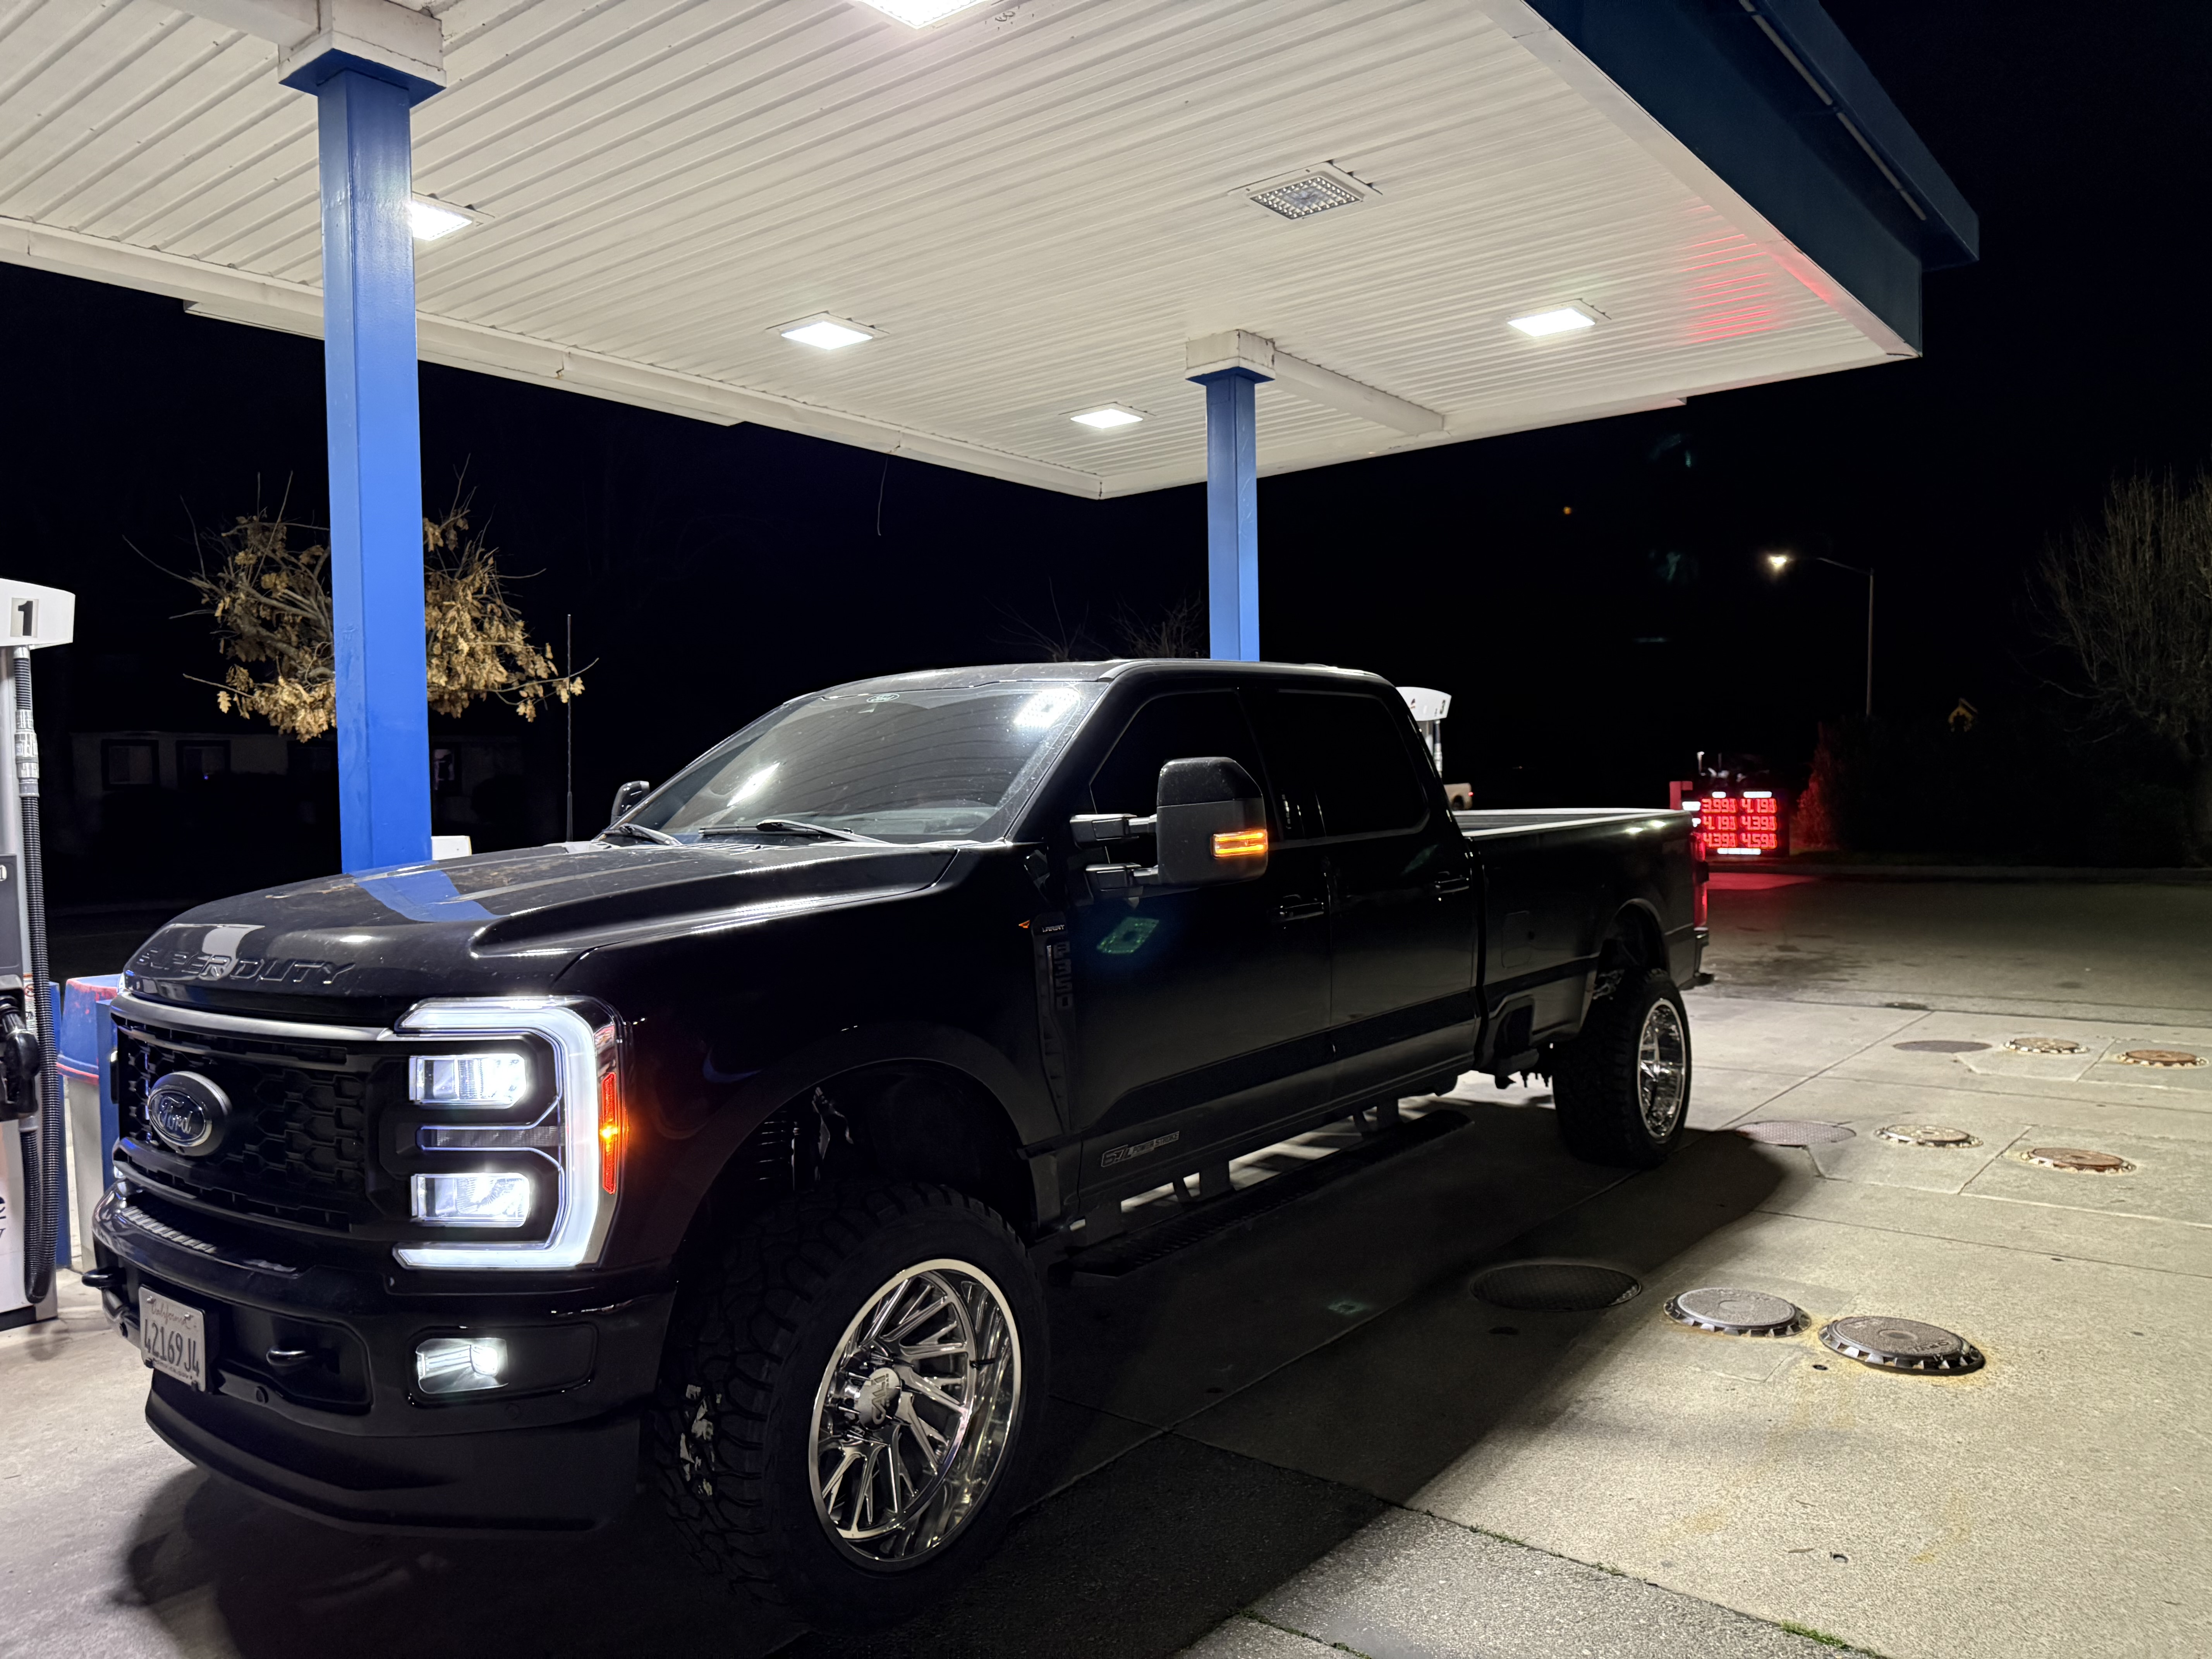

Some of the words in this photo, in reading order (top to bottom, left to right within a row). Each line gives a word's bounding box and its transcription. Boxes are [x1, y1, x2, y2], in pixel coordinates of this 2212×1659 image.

[18, 600, 33, 636] 1
[230, 958, 355, 984] DUTY
[158, 1096, 193, 1134] Ford
